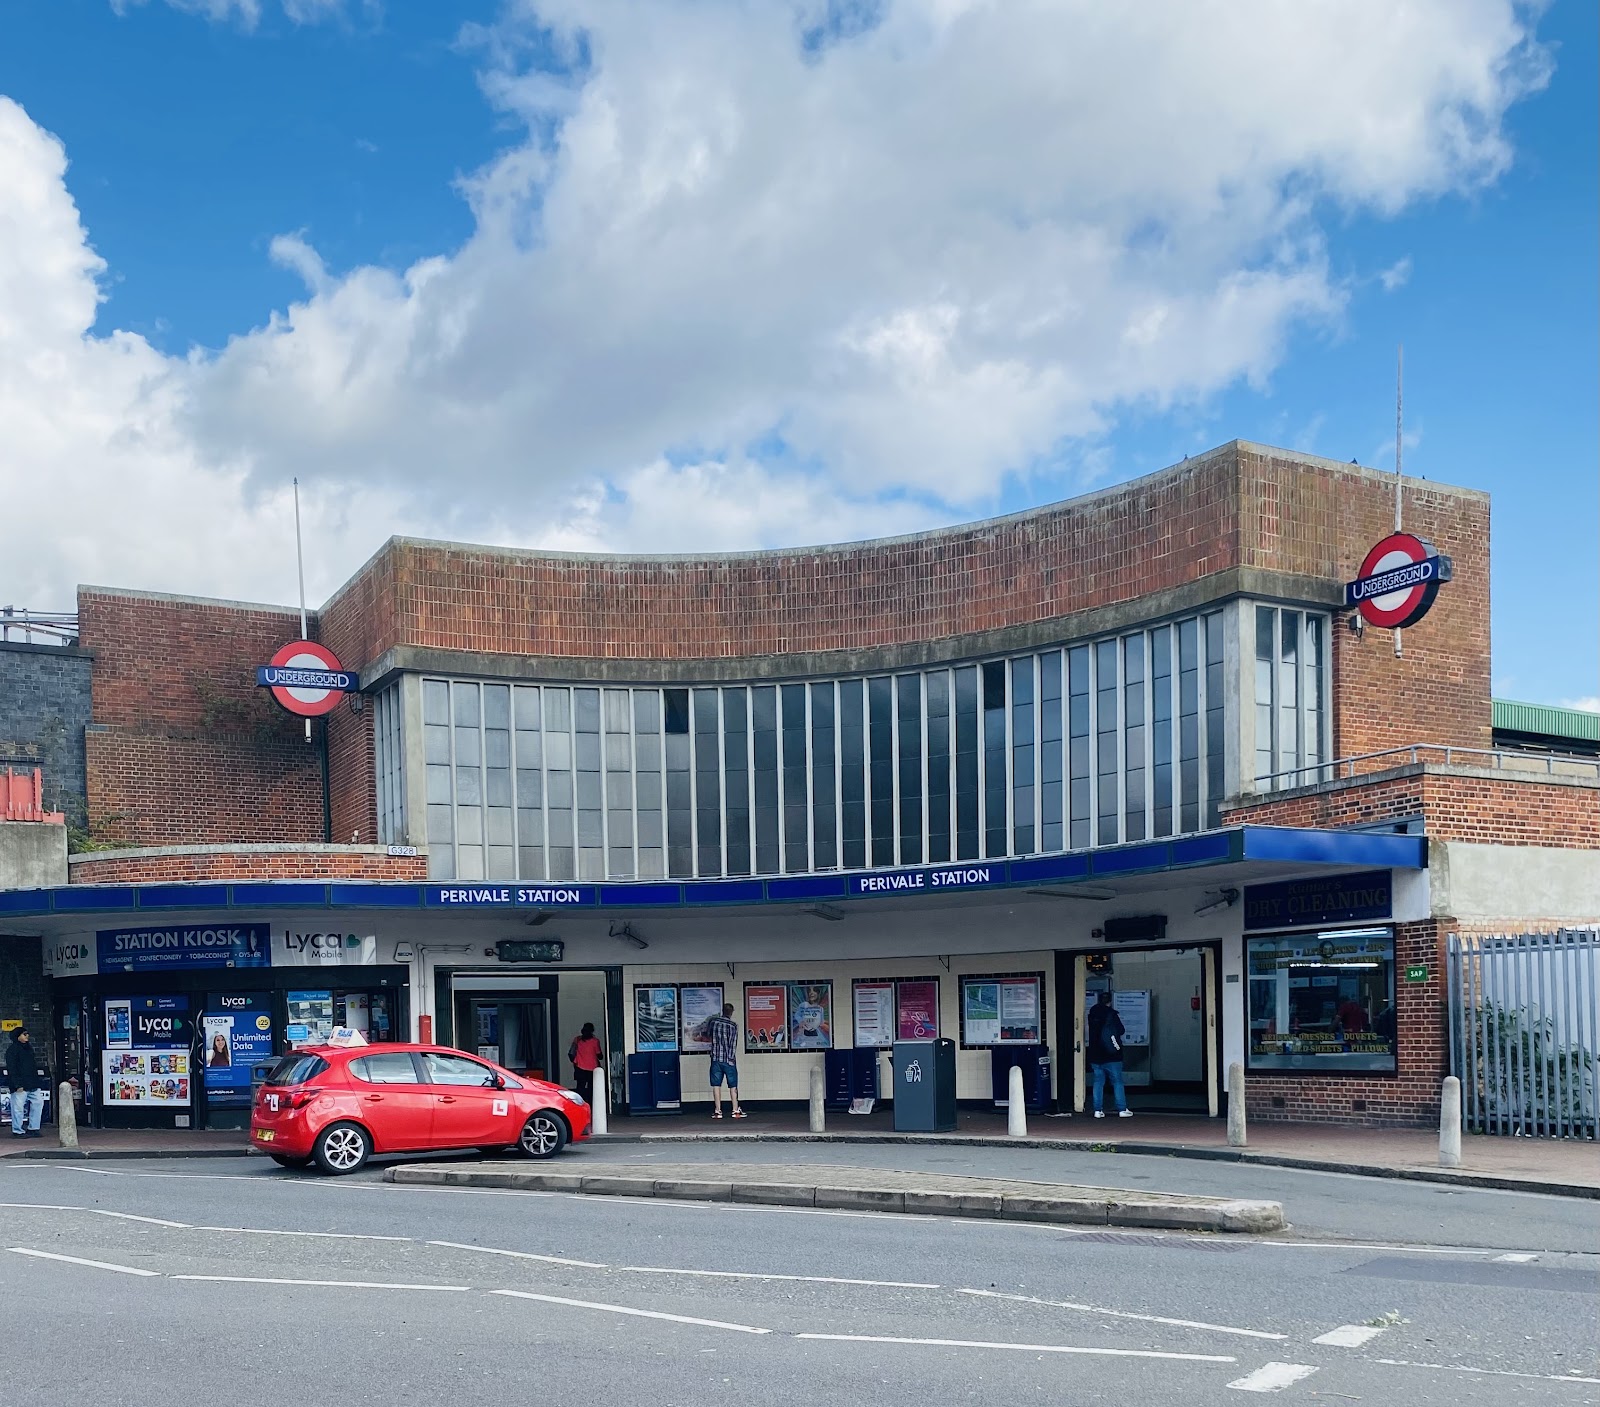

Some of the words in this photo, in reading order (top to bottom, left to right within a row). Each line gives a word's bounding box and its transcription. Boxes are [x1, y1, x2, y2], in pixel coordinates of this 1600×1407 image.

[1353, 562, 1433, 600] UNDERGROUND
[265, 668, 350, 688] UNDERGROUND
[391, 846, 414, 855] G328
[860, 874, 925, 892] PERIVALE
[931, 868, 990, 886] STATION
[440, 889, 510, 903] PERIVALE
[518, 889, 580, 903] STATION
[1248, 898, 1283, 918] DRY
[1287, 888, 1388, 914] CLEANING
[115, 931, 179, 951] STATION
[183, 929, 242, 947] KIOSK
[285, 930, 342, 953] Lyca
[56, 944, 79, 964] Lyca
[189, 952, 231, 960] TOBACCONIST
[311, 950, 343, 959] Mobile
[1410, 970, 1423, 978] SAP
[221, 996, 245, 1007] Lyca
[139, 1015, 172, 1033] Lyca
[232, 1033, 272, 1042] Unlimited
[1344, 1032, 1378, 1041] DUVETS
[232, 1042, 253, 1050] Data
[1351, 1044, 1389, 1053] PILLOWS
[497, 1103, 504, 1112] L
